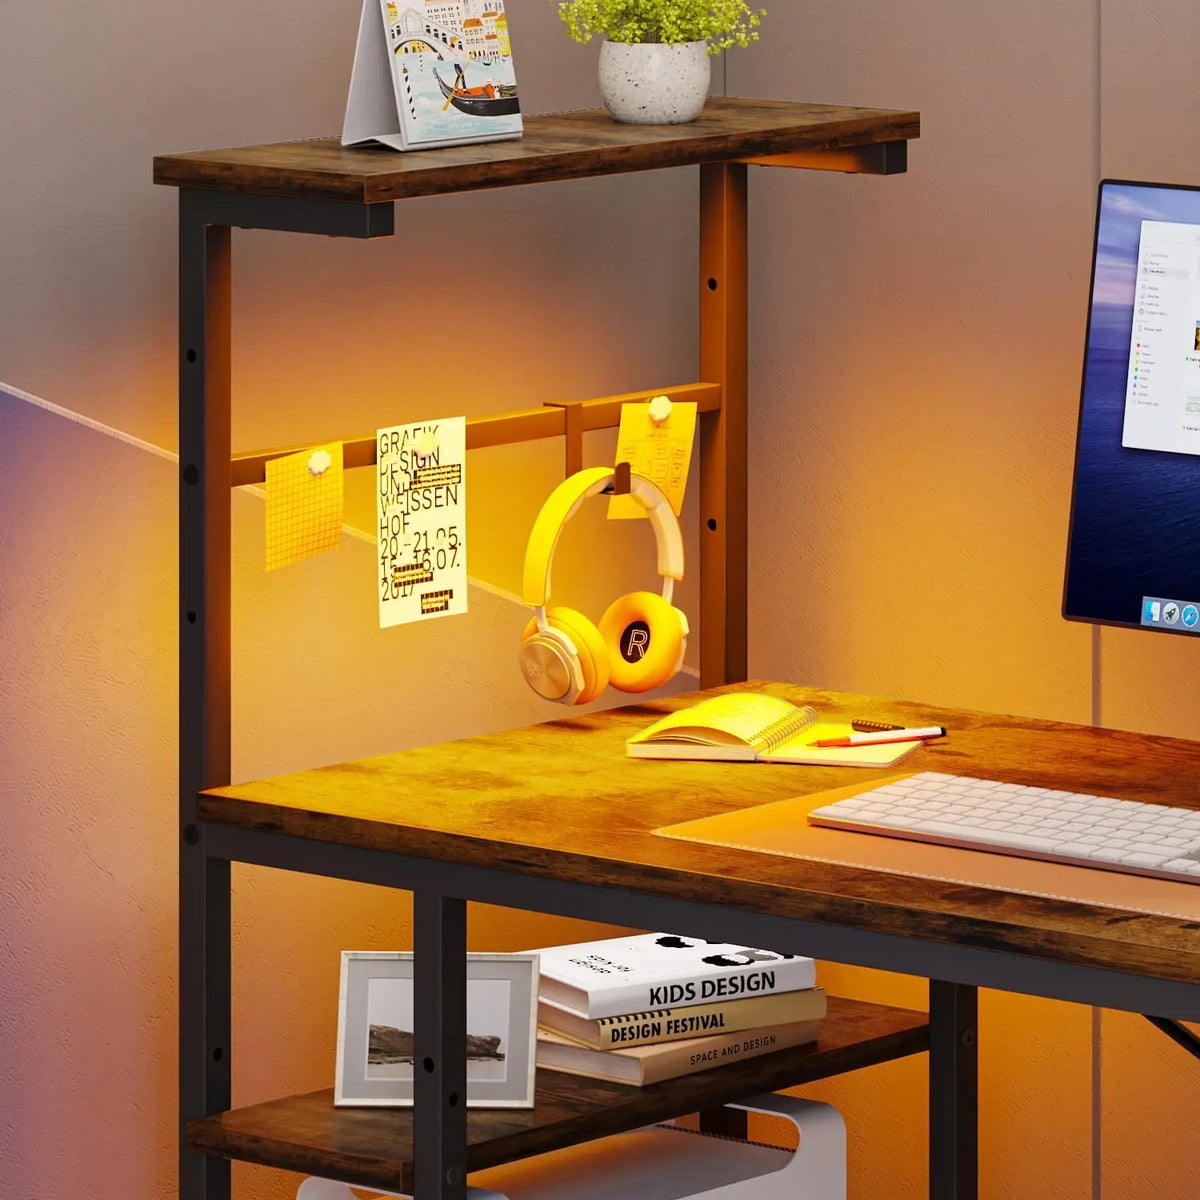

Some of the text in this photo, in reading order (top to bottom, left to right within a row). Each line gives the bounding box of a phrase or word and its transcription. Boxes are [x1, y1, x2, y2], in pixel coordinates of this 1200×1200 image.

[379, 424, 439, 454] GRA
[380, 509, 410, 539] HOF
[627, 629, 648, 658] R
[649, 970, 775, 1006] KIDS DESIGN
[611, 1012, 725, 1043] DESIGN FESTIVAL
[690, 1034, 776, 1066] SPACE AND DESIGN
